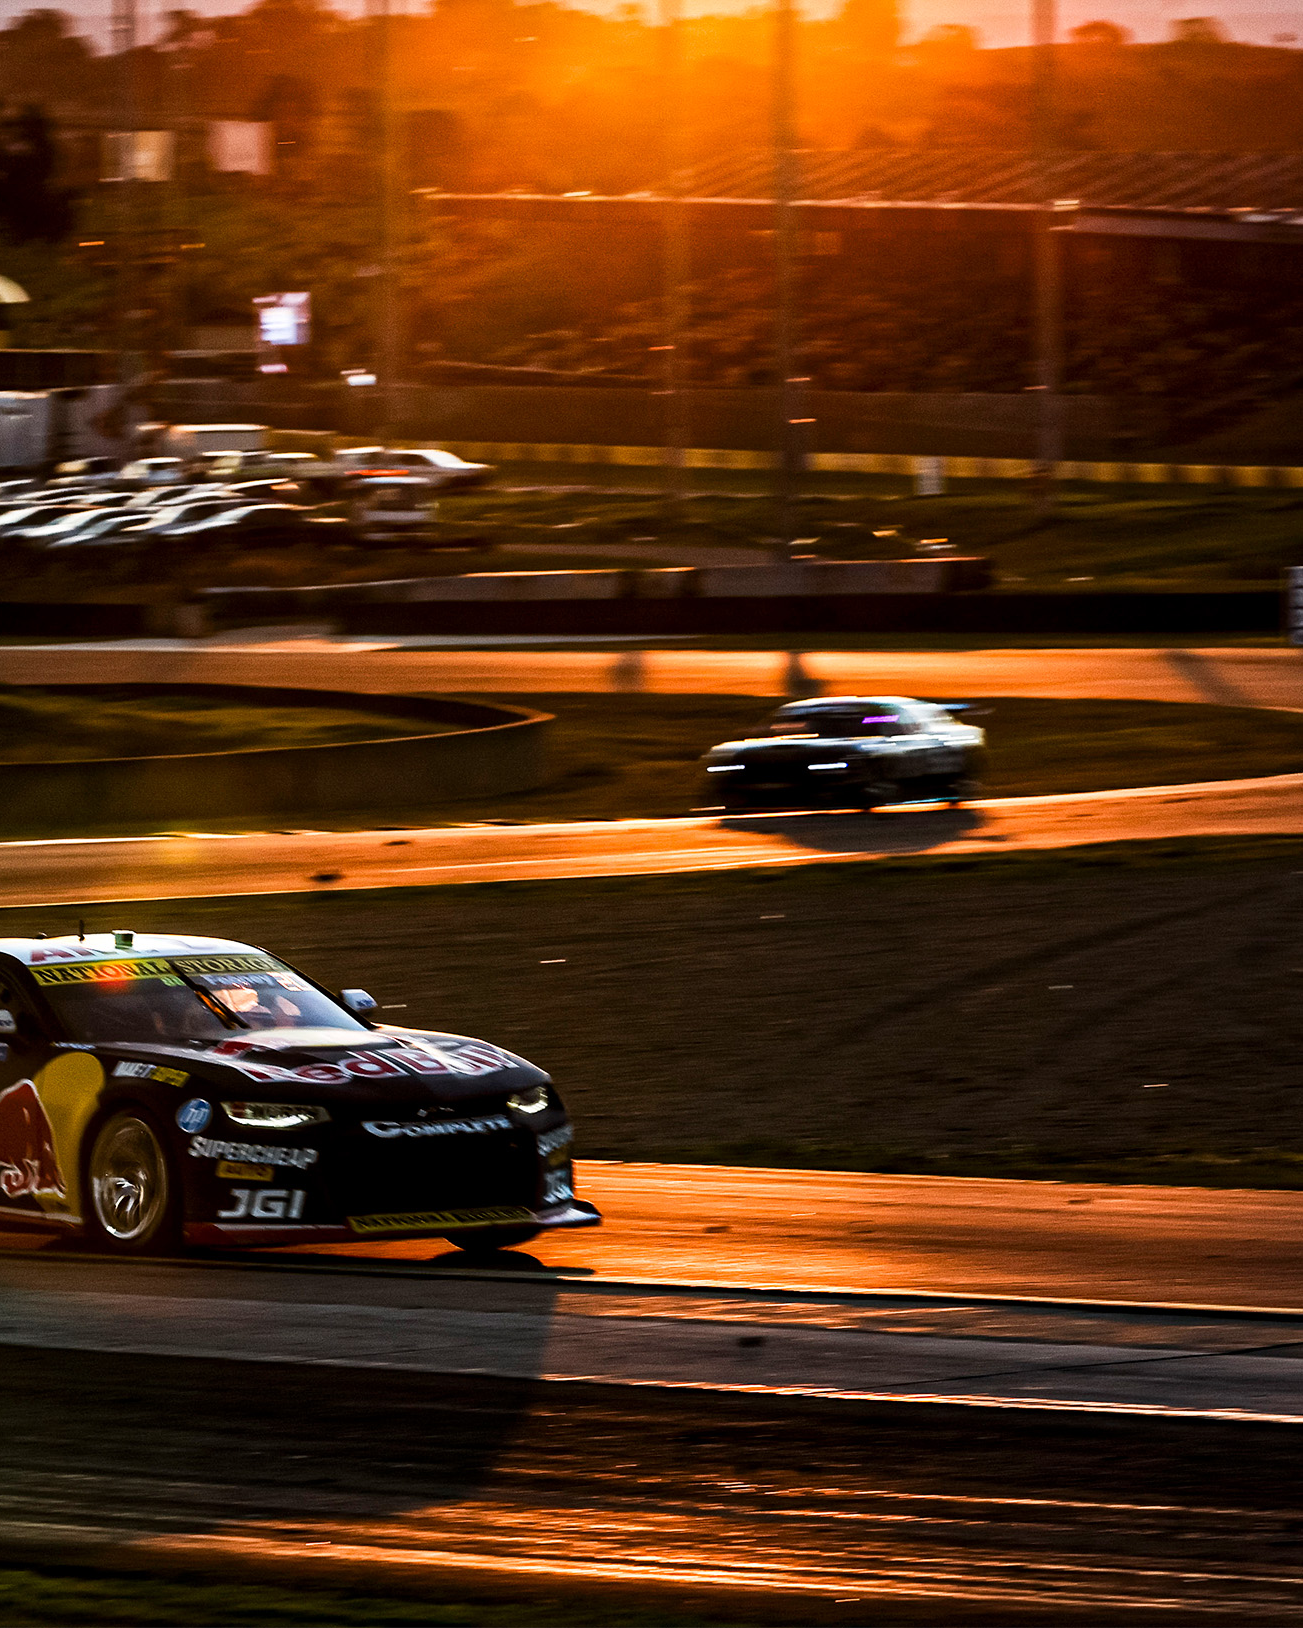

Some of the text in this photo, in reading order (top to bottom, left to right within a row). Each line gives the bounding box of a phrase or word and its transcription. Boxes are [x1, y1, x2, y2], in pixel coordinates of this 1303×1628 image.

[35, 955, 288, 984] NATIONAL STORAGE
[187, 1134, 320, 1170] SUPERCHEAP
[216, 1188, 308, 1219] JGI
